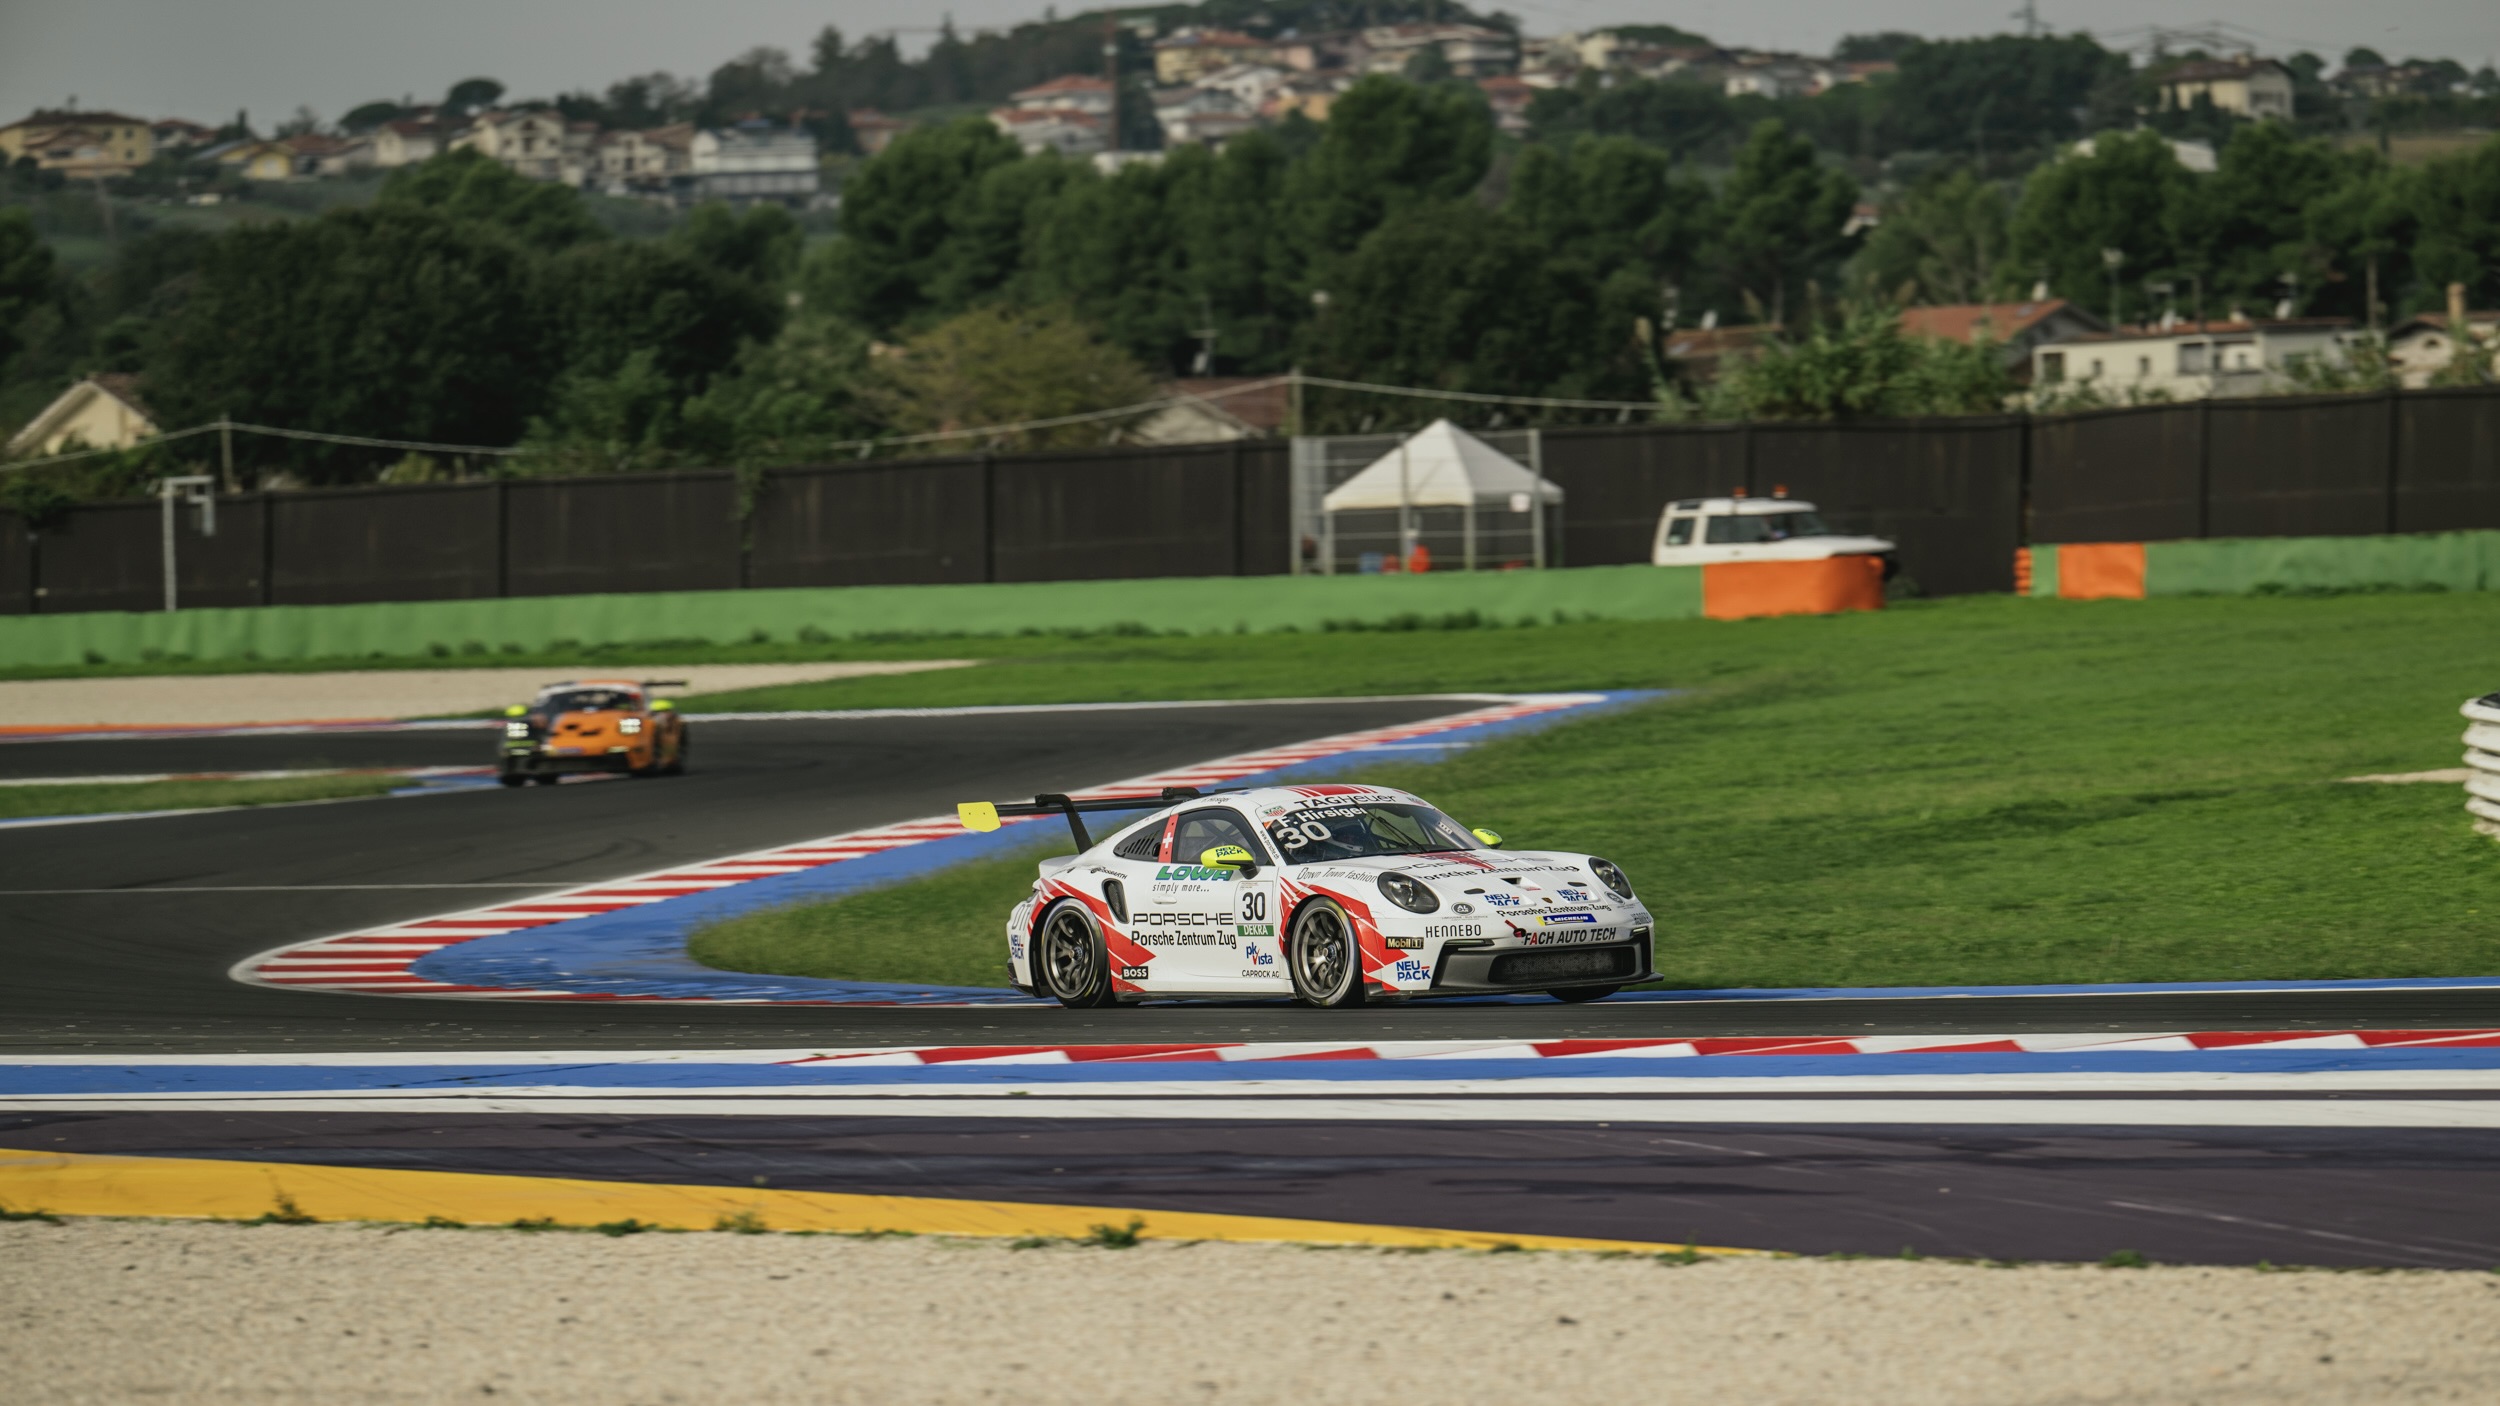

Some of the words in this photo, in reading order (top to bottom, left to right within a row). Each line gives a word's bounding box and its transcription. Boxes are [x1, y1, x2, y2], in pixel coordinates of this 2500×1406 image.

[1277, 816, 1298, 828] F.
[1276, 821, 1332, 849] 30
[1216, 848, 1244, 857] PACK
[1155, 866, 1234, 881] LOWA
[1345, 869, 1378, 883] fashion
[1418, 868, 1478, 881] orsche
[1475, 864, 1546, 875] Zentrum
[1542, 865, 1580, 874] Zug
[1152, 882, 1179, 893] simply
[1181, 882, 1210, 892] more...
[1484, 893, 1511, 901] NEU
[1242, 892, 1265, 921] 30
[1496, 906, 1548, 917] Porsche
[1545, 903, 1592, 914] Zentrum
[1592, 903, 1612, 911] Zug
[1133, 913, 1233, 925] PORSCHE
[1243, 925, 1268, 935] DEKRA
[1425, 924, 1482, 938] HENNEBO
[1523, 931, 1553, 945] FACH
[1556, 929, 1589, 943] AUTO
[1590, 927, 1616, 941] TECH
[1131, 930, 1174, 946] Porsche
[1176, 930, 1216, 946] Zentrum
[1218, 930, 1237, 949] Zug
[1387, 938, 1411, 948] Mobil
[1396, 960, 1421, 971] NEU
[1123, 968, 1147, 977] BOSS
[1242, 969, 1271, 978] CAPROCK
[1272, 970, 1280, 979] AG
[1397, 970, 1431, 982] PACK
